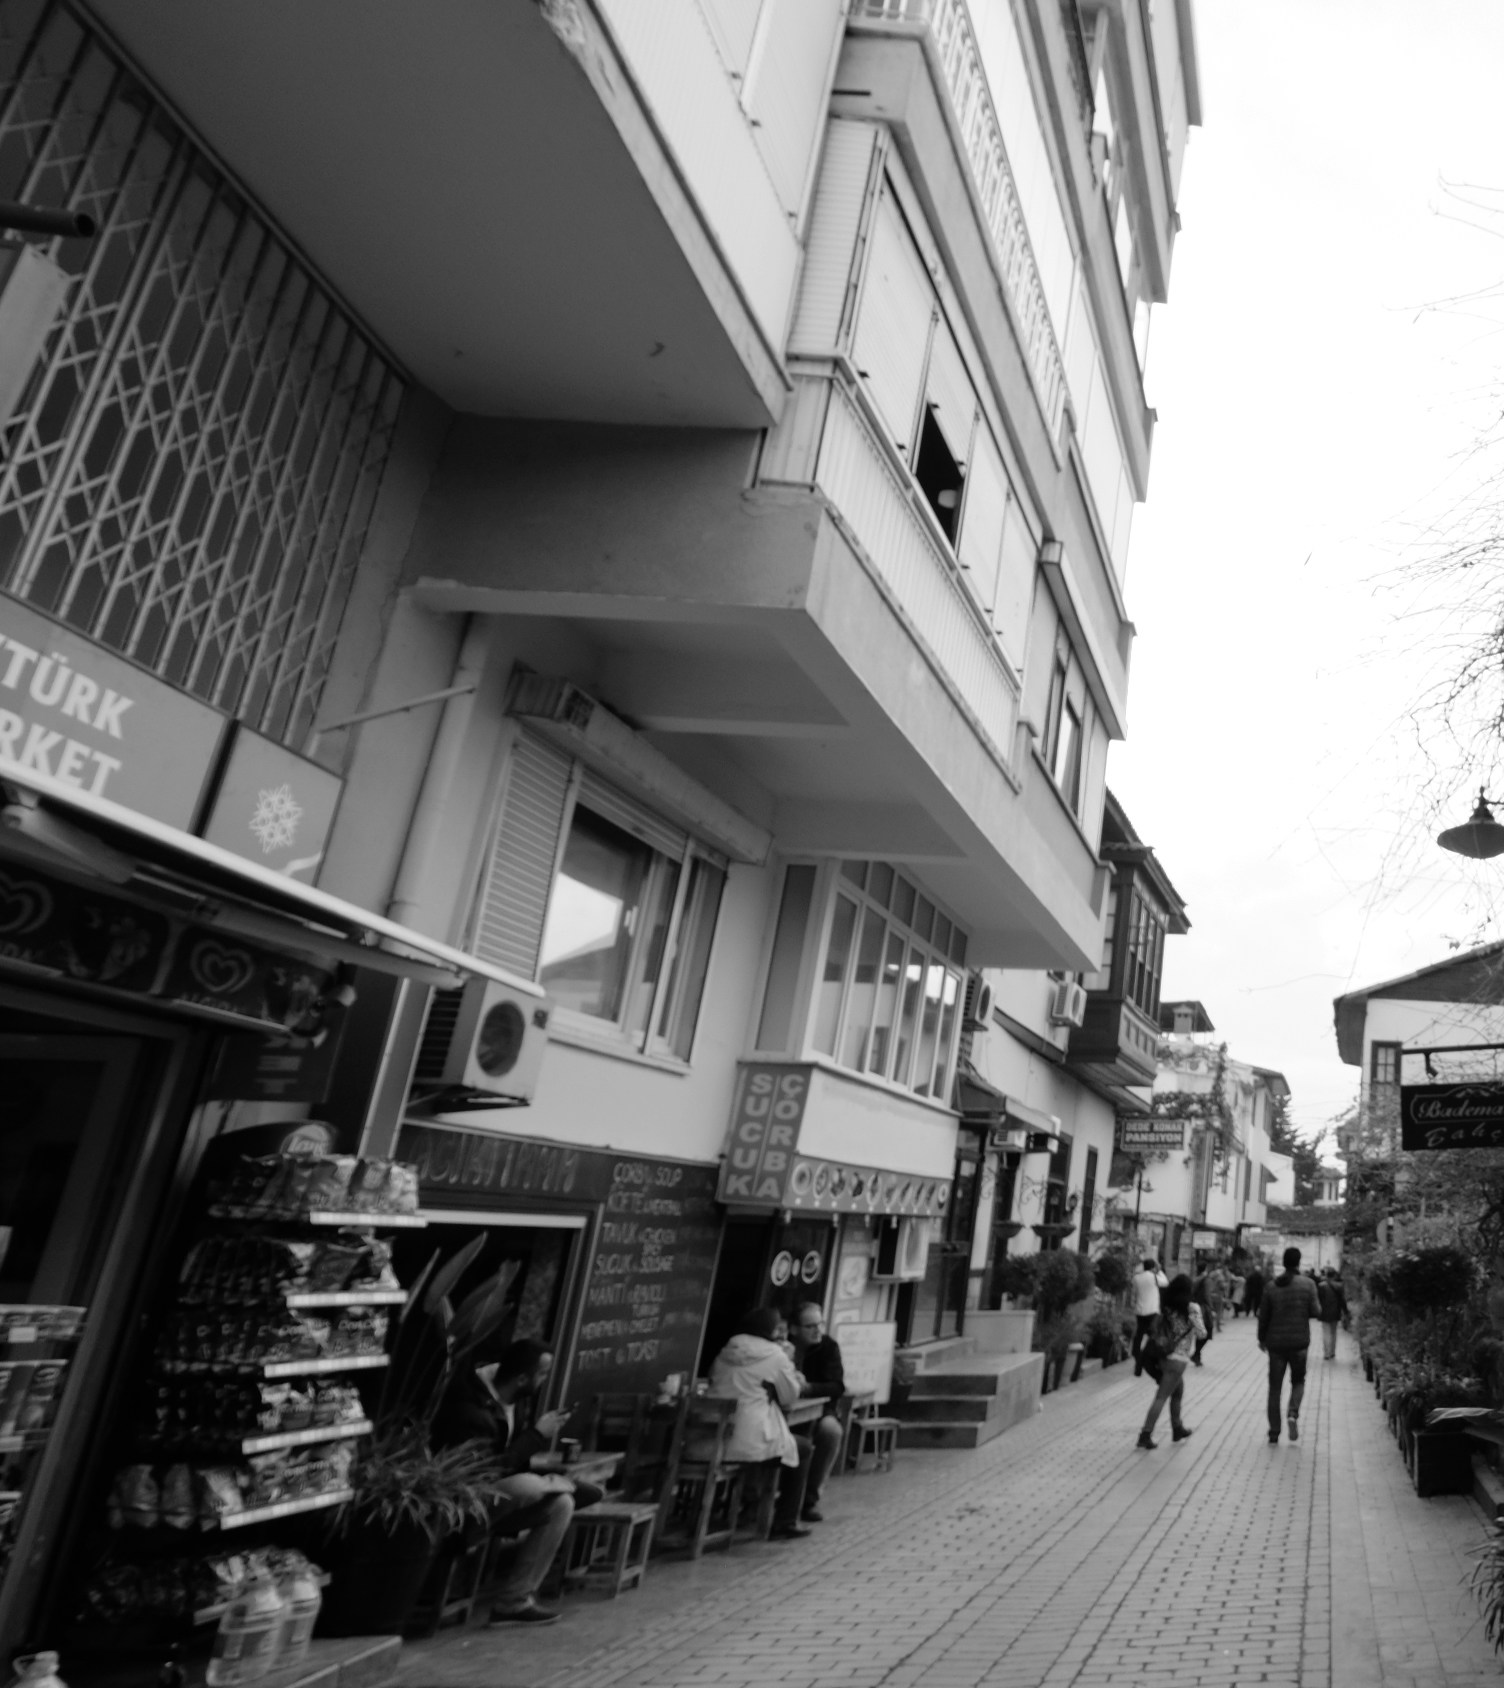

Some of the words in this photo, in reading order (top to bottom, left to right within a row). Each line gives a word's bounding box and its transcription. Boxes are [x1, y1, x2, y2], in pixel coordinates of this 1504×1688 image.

[0, 632, 135, 740] TÜRK
[725, 1073, 773, 1197] SUCUK
[756, 1073, 805, 1199] ÇORBA
